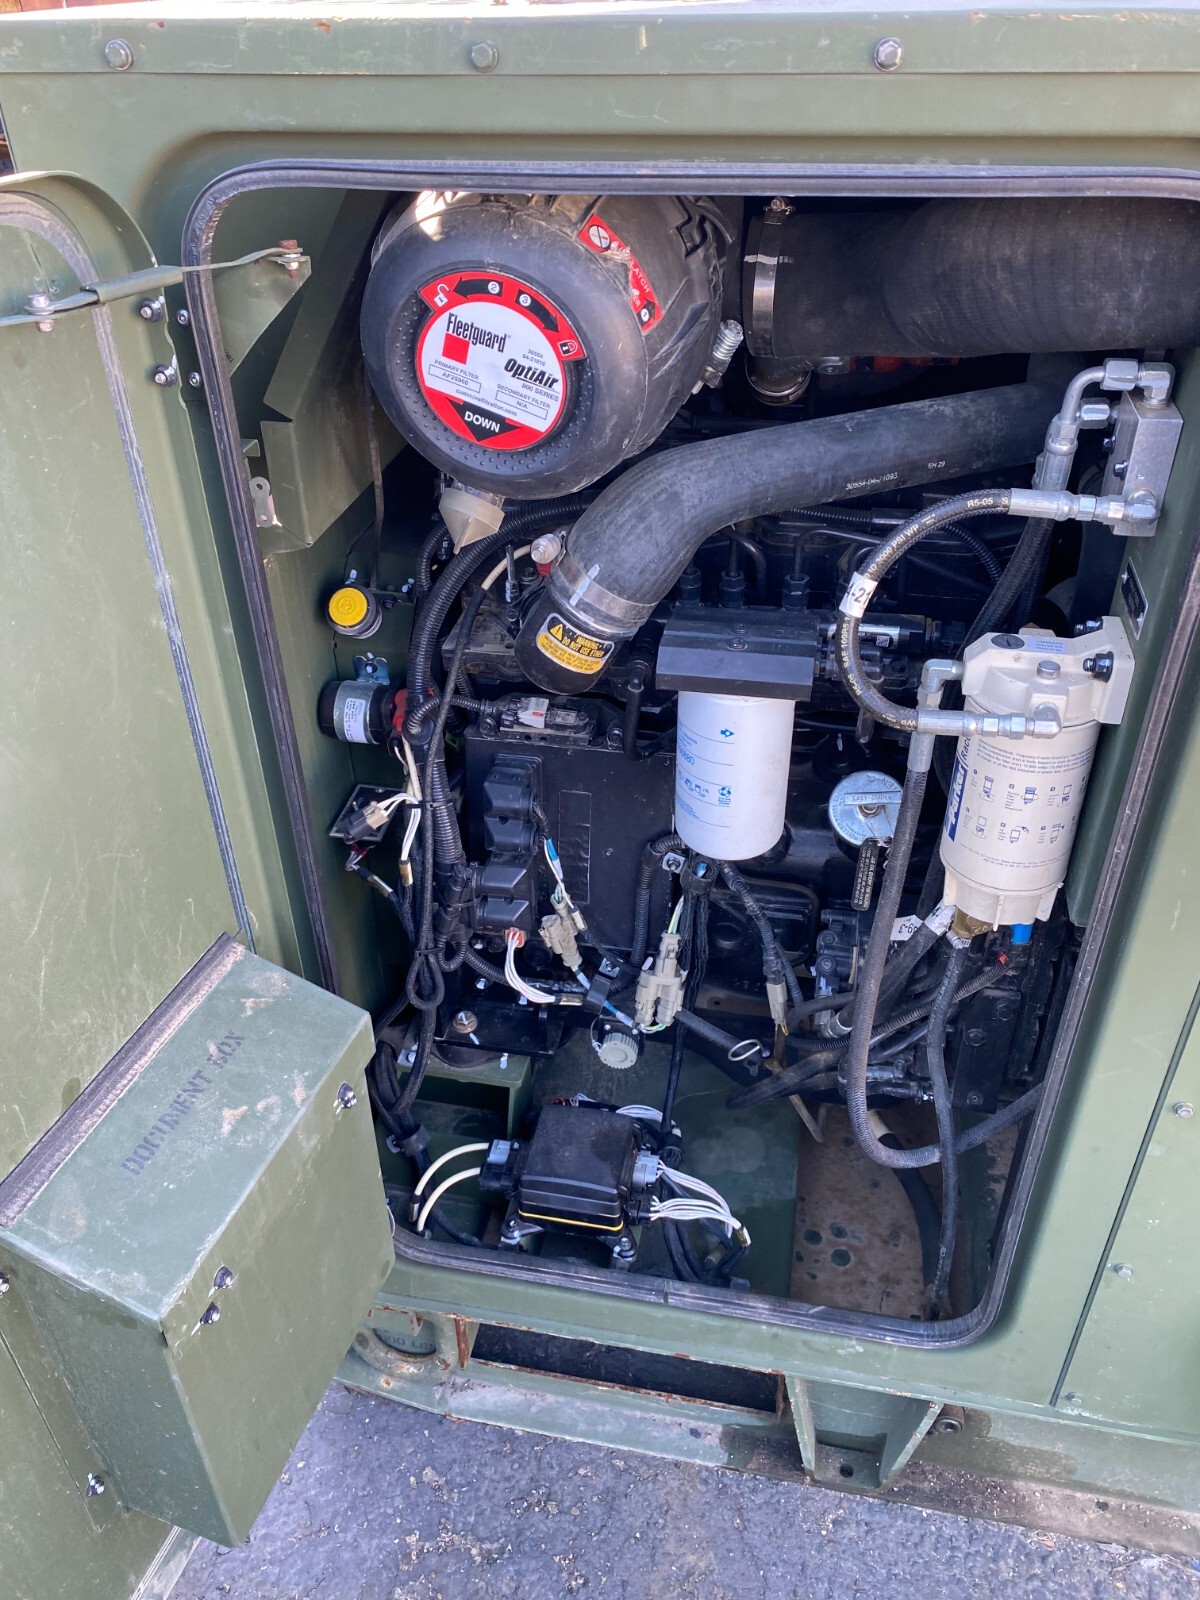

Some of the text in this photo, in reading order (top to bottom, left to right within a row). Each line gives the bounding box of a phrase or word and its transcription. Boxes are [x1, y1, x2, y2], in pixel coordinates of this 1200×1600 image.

[446, 312, 509, 354] Fleetguard
[434, 359, 479, 381] PRIMARY FILTER
[504, 357, 560, 389] OptiAir
[496, 384, 551, 410] SECONDARY FILTER
[535, 386, 559, 402] SERIES
[464, 410, 501, 433] DOWN
[967, 497, 994, 508] R5-05
[891, 534, 906, 549] PSI
[906, 524, 919, 537] WP
[121, 1029, 247, 1175] DOCUMENT BOX
